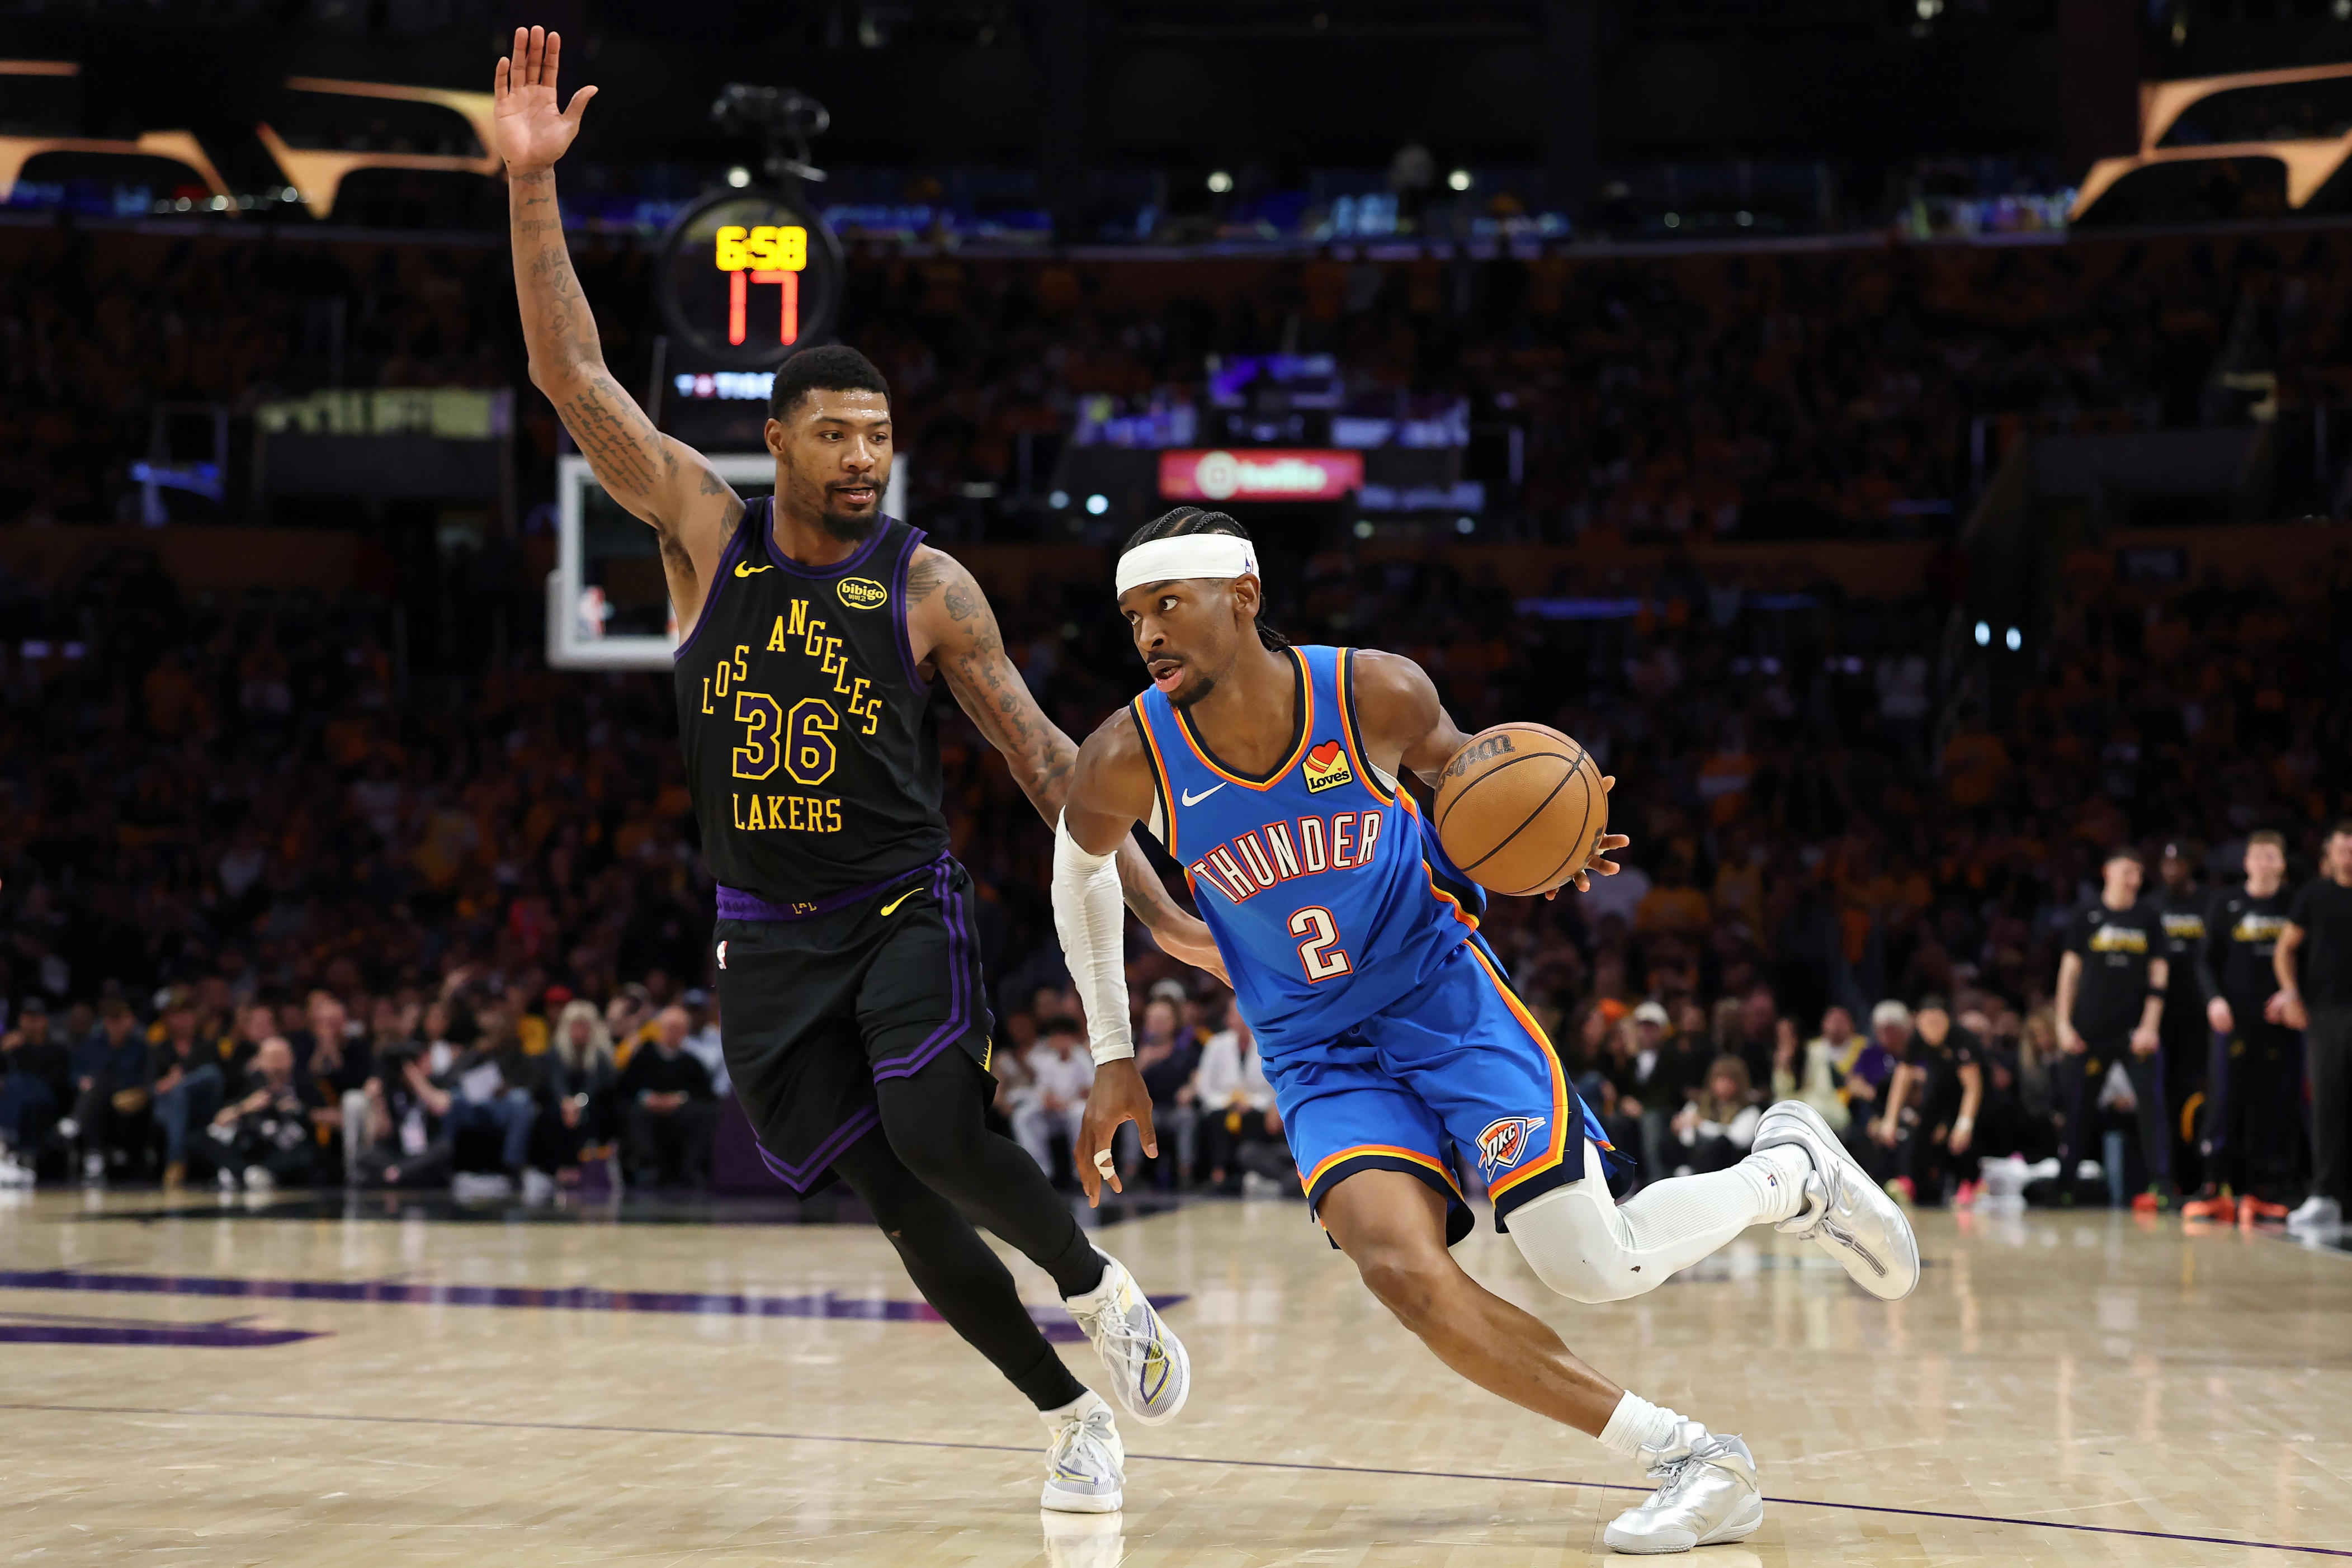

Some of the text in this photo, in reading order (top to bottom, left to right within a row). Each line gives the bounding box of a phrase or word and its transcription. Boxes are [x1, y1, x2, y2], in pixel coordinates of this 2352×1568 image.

[716, 225, 807, 272] 6:58
[729, 270, 799, 346] 17
[842, 583, 884, 601] bibigo
[702, 599, 882, 735] LOS ANGELES
[731, 691, 839, 786] 36
[733, 793, 842, 833] LAKERS
[1188, 810, 1382, 905] THUNDER
[1287, 905, 1353, 984] 2
[1486, 1124, 1516, 1167] OKC
